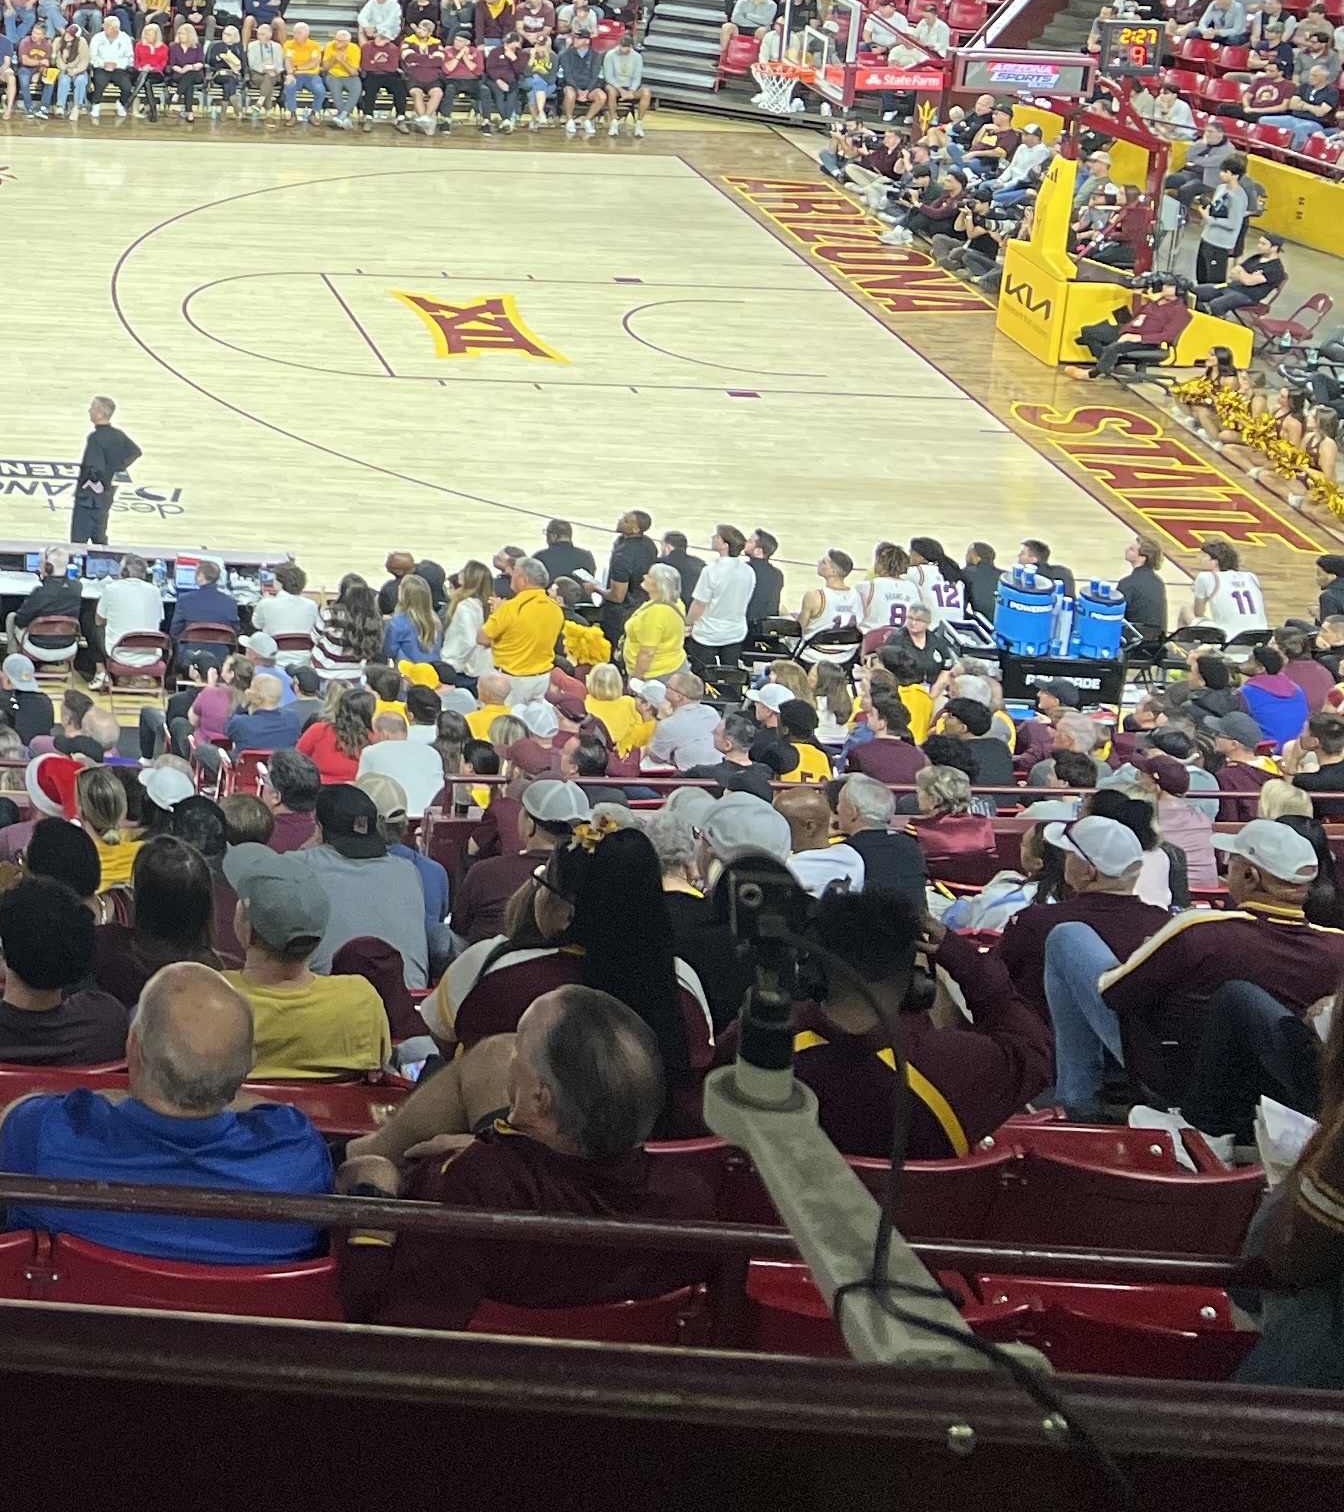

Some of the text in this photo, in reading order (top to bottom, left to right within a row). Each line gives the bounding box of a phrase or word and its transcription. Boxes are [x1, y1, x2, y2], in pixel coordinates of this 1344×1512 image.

[1119, 27, 1158, 44] 2:27
[1129, 44, 1147, 66] 9
[996, 72, 1052, 83] SPORTS
[720, 175, 999, 315] ARIZONA
[1008, 401, 1328, 556] STATE
[932, 582, 960, 608] 12
[1232, 590, 1256, 615] 11
[889, 603, 907, 628] 8
